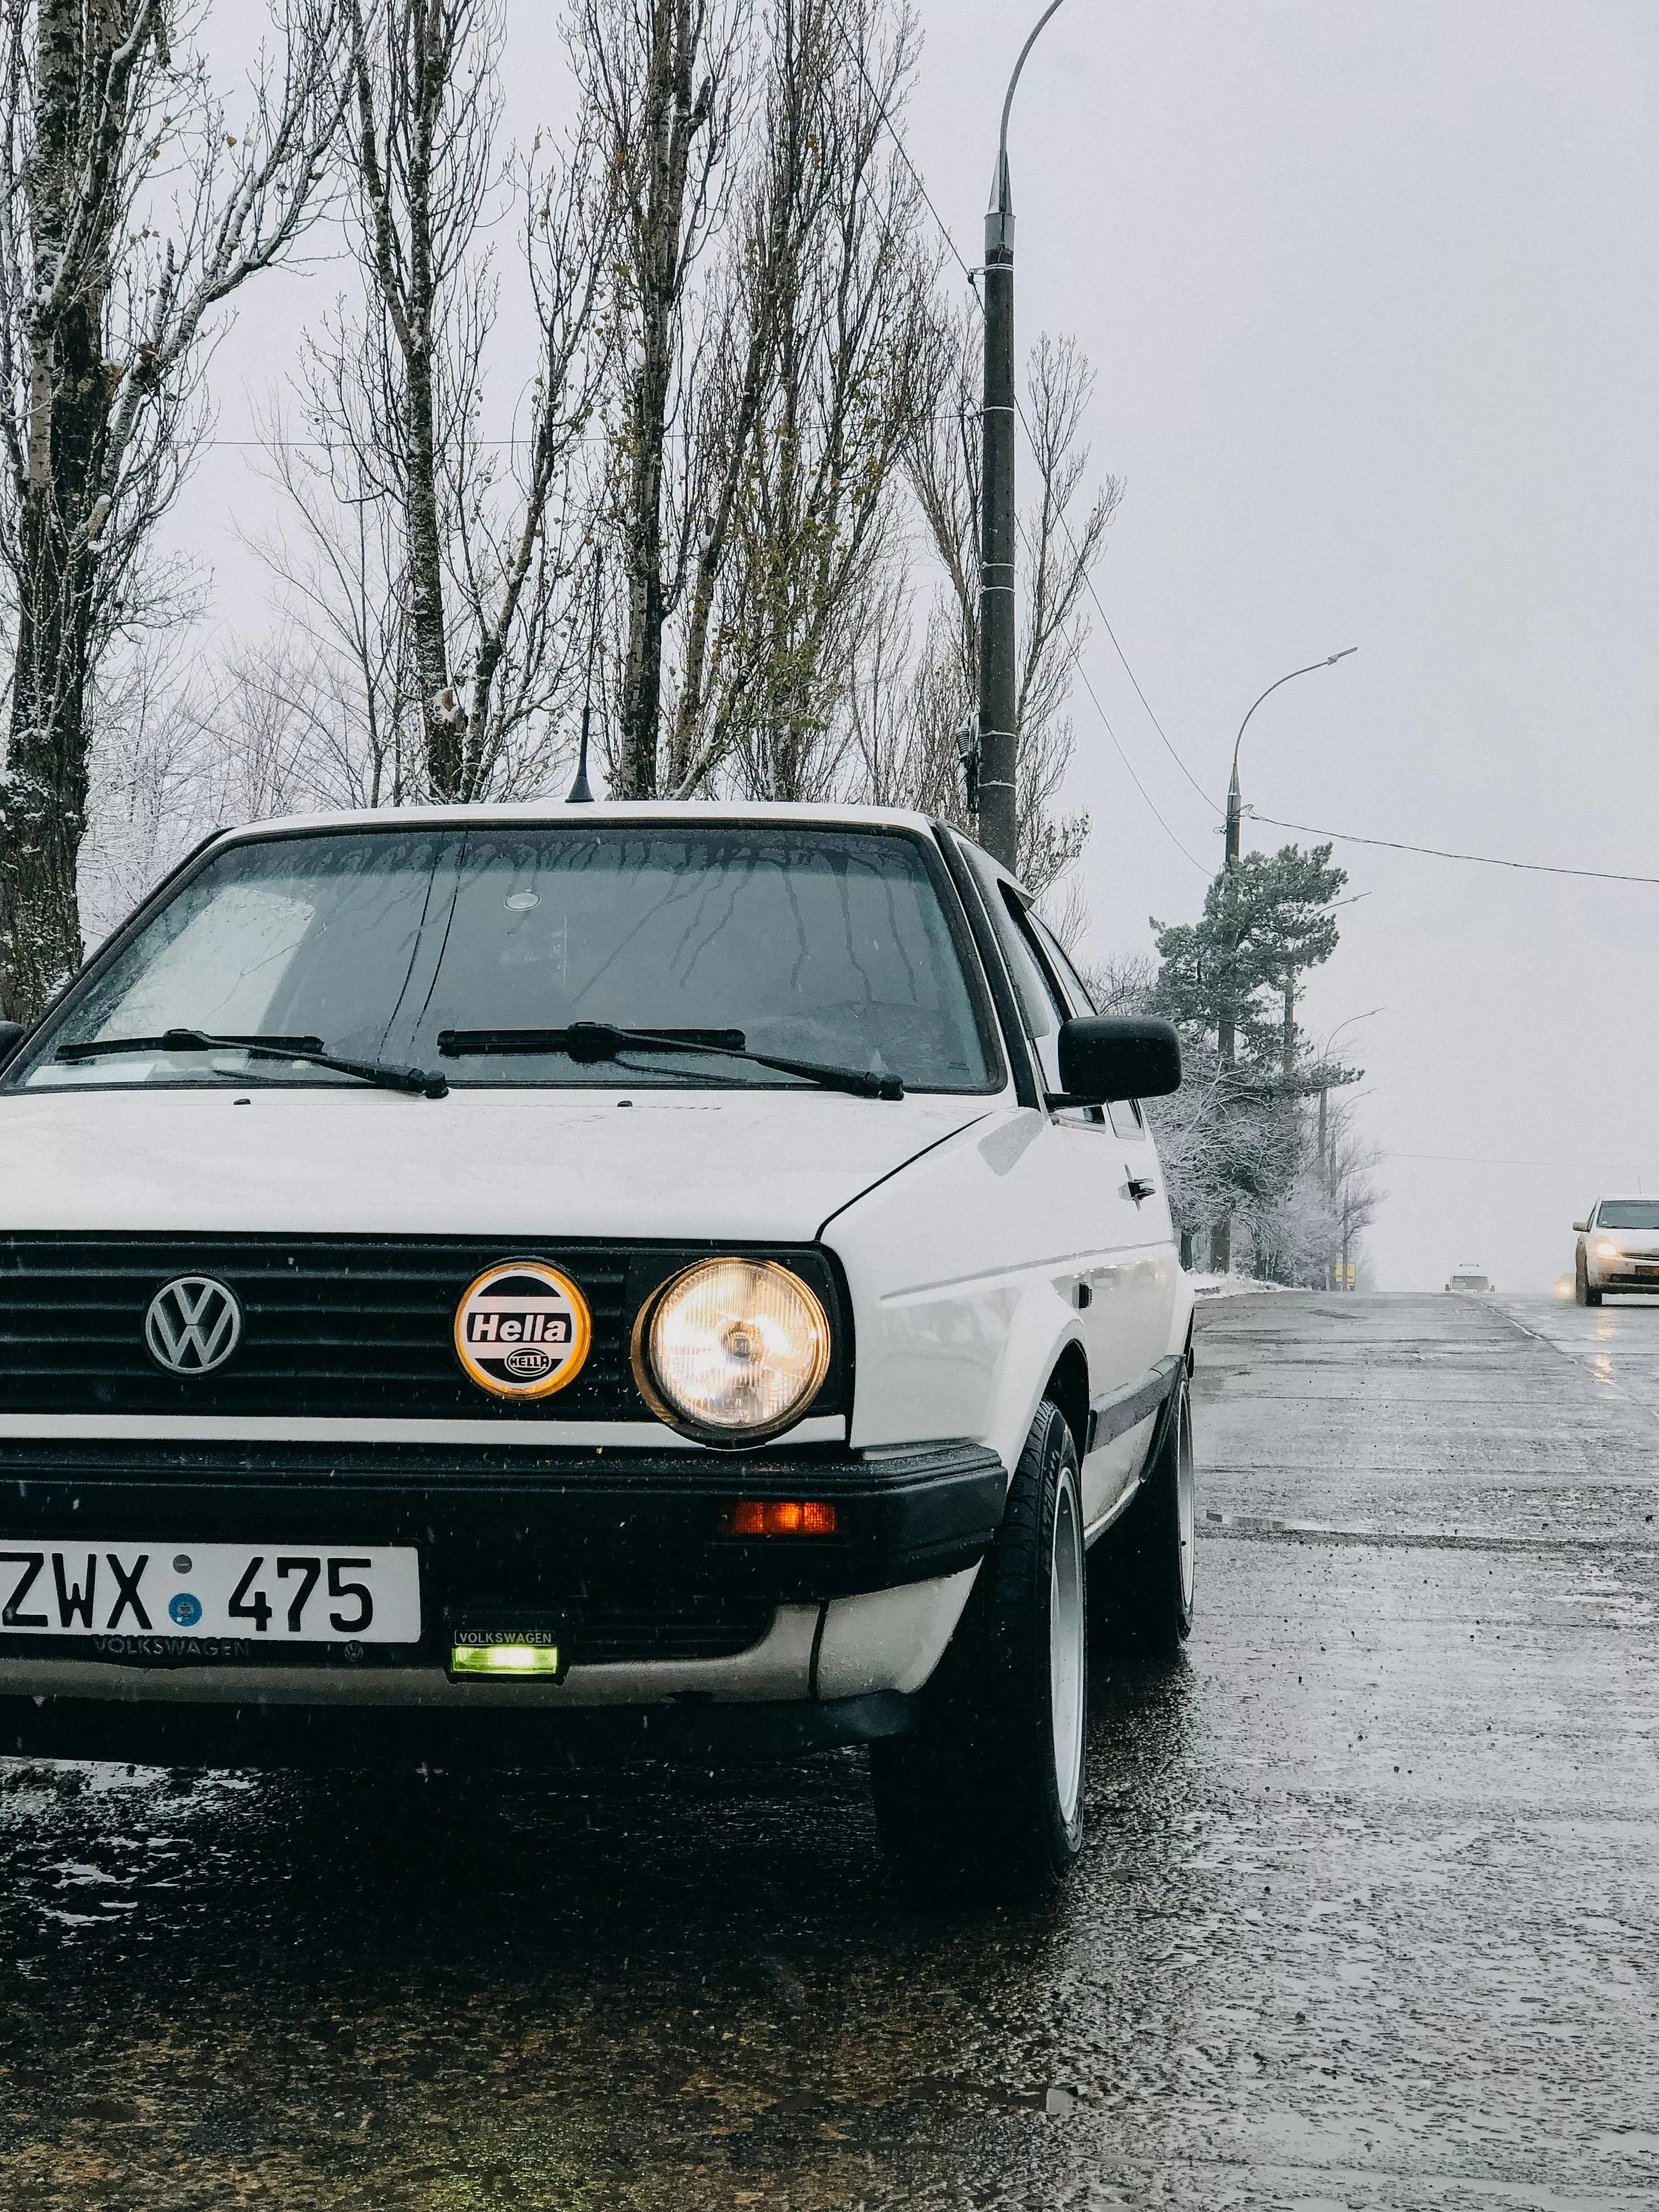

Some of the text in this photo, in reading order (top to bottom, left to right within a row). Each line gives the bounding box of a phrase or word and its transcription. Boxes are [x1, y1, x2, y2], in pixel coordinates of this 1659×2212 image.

[472, 1315, 566, 1342] Hella
[510, 1356, 549, 1367] HELLA
[0, 1552, 373, 1632] ZWX 475
[93, 1637, 249, 1656] VOLKSWAGEN
[459, 1633, 552, 1643] VOLKSWAGEN
